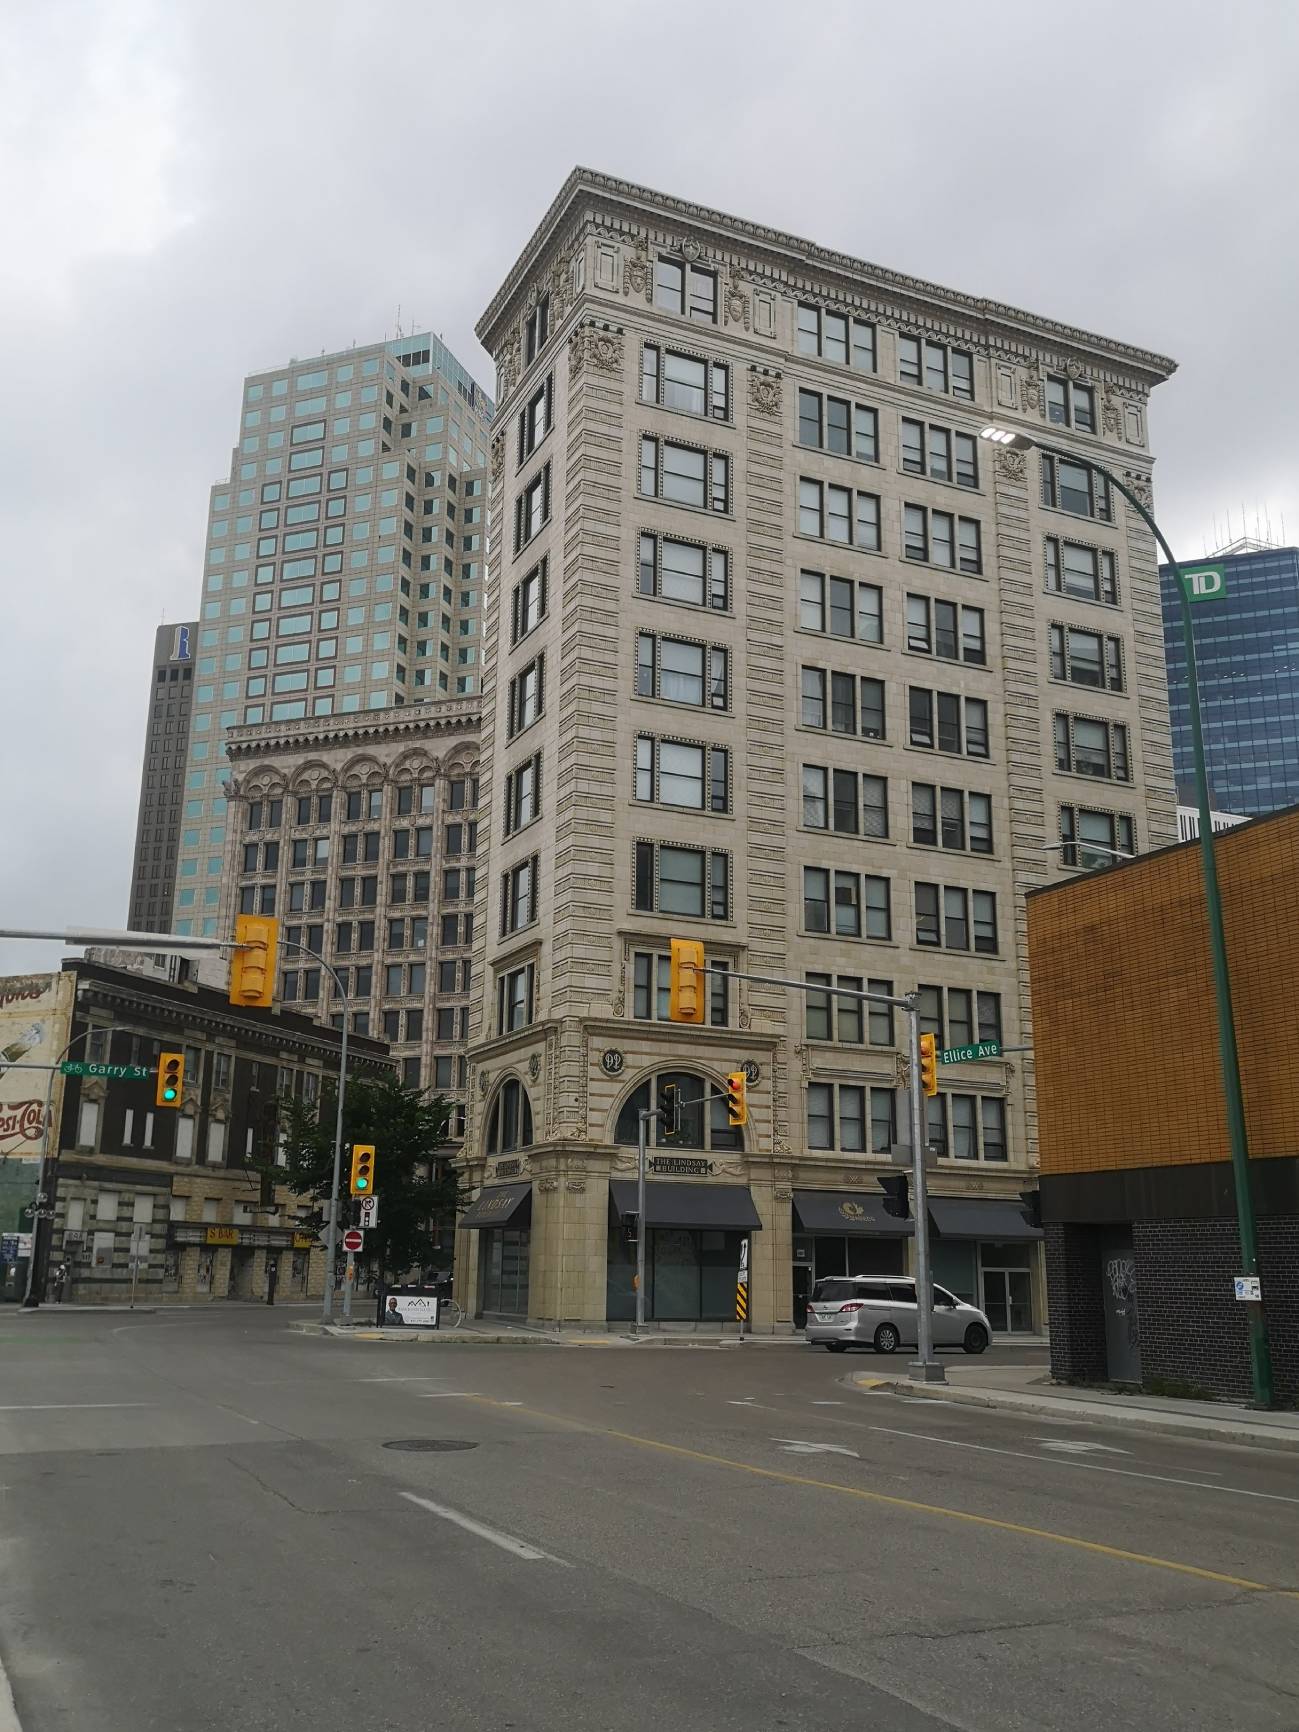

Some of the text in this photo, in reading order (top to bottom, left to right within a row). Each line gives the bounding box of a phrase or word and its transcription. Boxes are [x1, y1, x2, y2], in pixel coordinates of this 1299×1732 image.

[1184, 571, 1221, 595] TD
[943, 1044, 997, 1063] Ellice Ave
[89, 1064, 148, 1078] Garry St
[662, 1165, 699, 1174] BUILDING
[674, 1159, 706, 1167] LINDSAY
